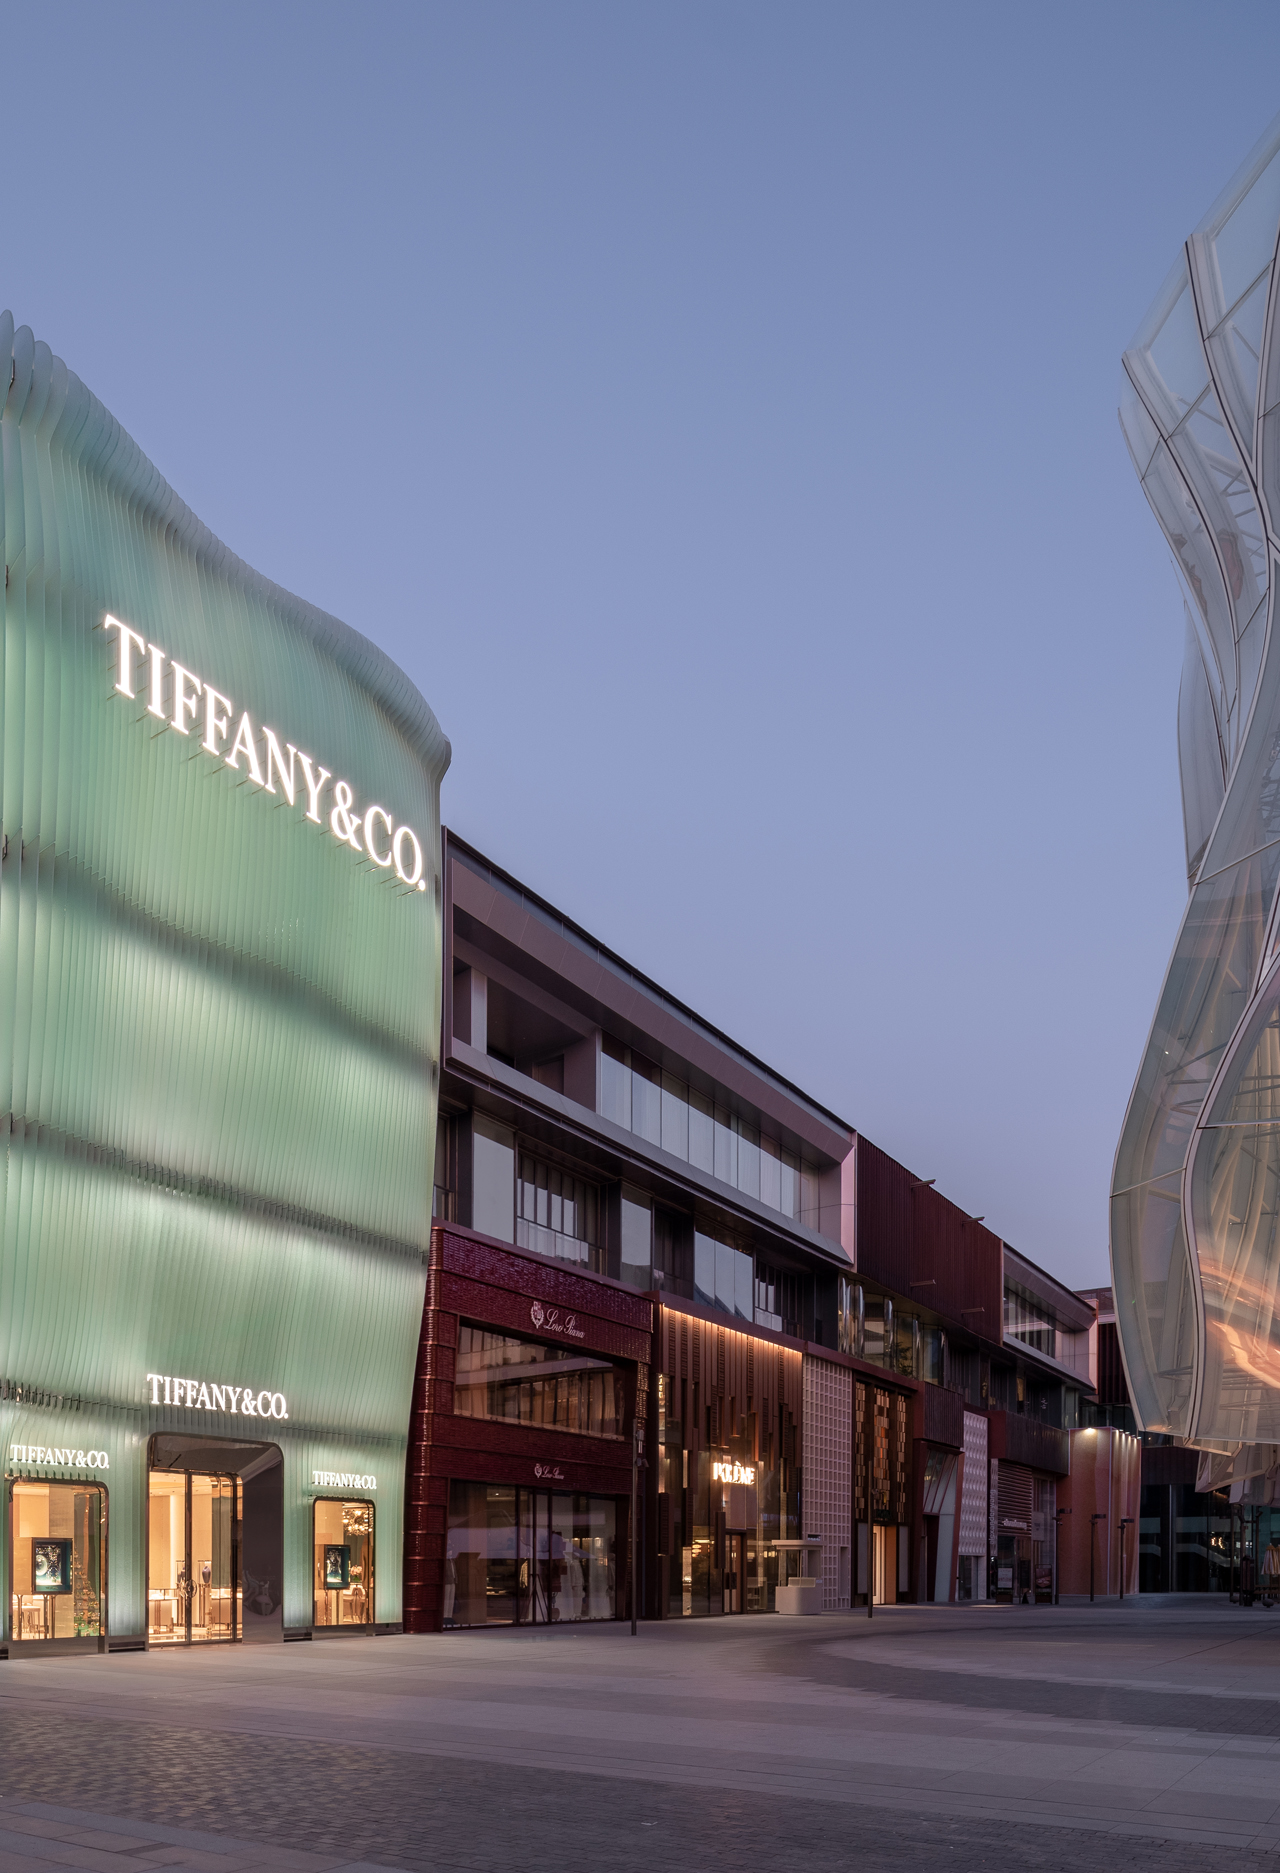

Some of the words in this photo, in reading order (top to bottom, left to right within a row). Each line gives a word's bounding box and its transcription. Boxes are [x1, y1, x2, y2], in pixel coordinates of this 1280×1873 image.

[104, 614, 426, 891] TIFFANY&CO.
[543, 1308, 564, 1332] Loro
[564, 1314, 585, 1339] Piana
[147, 1373, 288, 1419] TIFFANY&CO.
[10, 1444, 109, 1469] TIFFANY&CO.
[312, 1470, 377, 1490] TIFFANY&CO.
